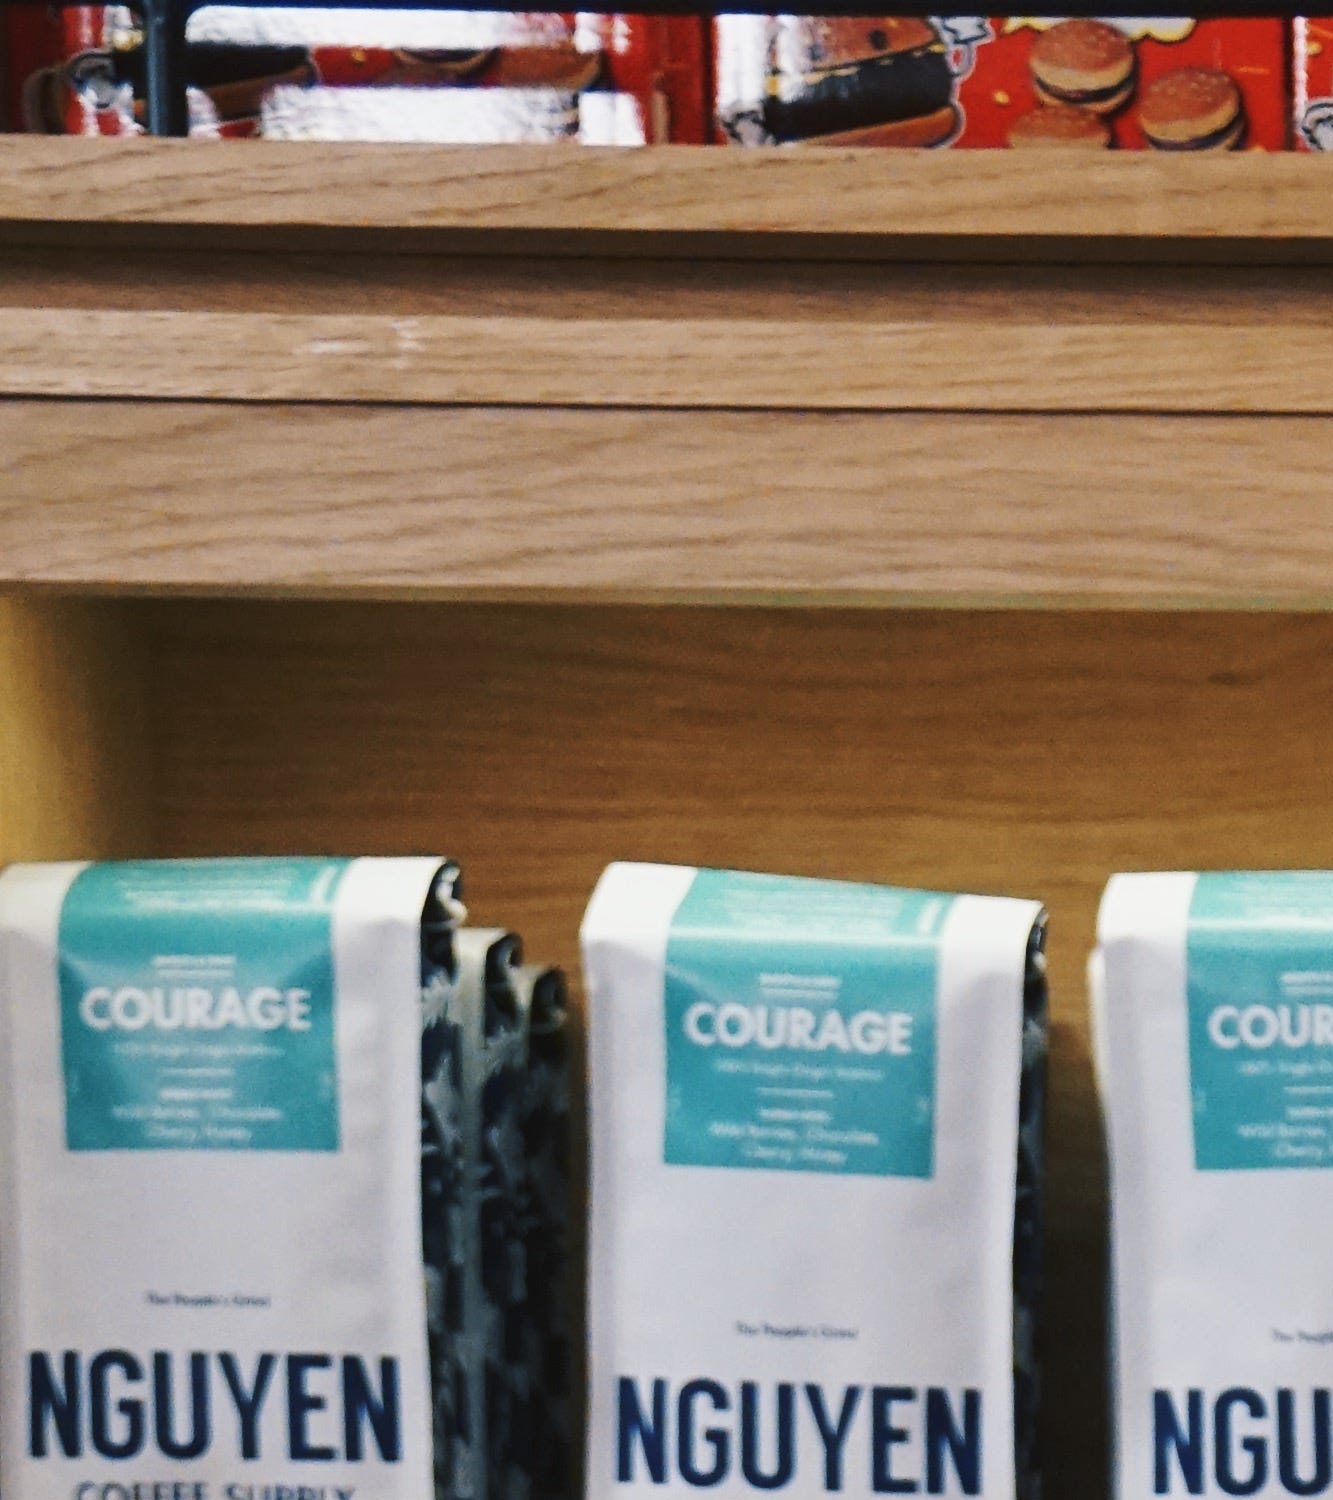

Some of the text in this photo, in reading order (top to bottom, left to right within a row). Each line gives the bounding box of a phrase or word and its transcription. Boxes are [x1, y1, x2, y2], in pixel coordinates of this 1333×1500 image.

[79, 986, 312, 1032] COURAGE
[683, 1002, 914, 1056] COURAGE
[28, 1348, 402, 1462] NGUYEN
[615, 1374, 984, 1497] NGUYEN
